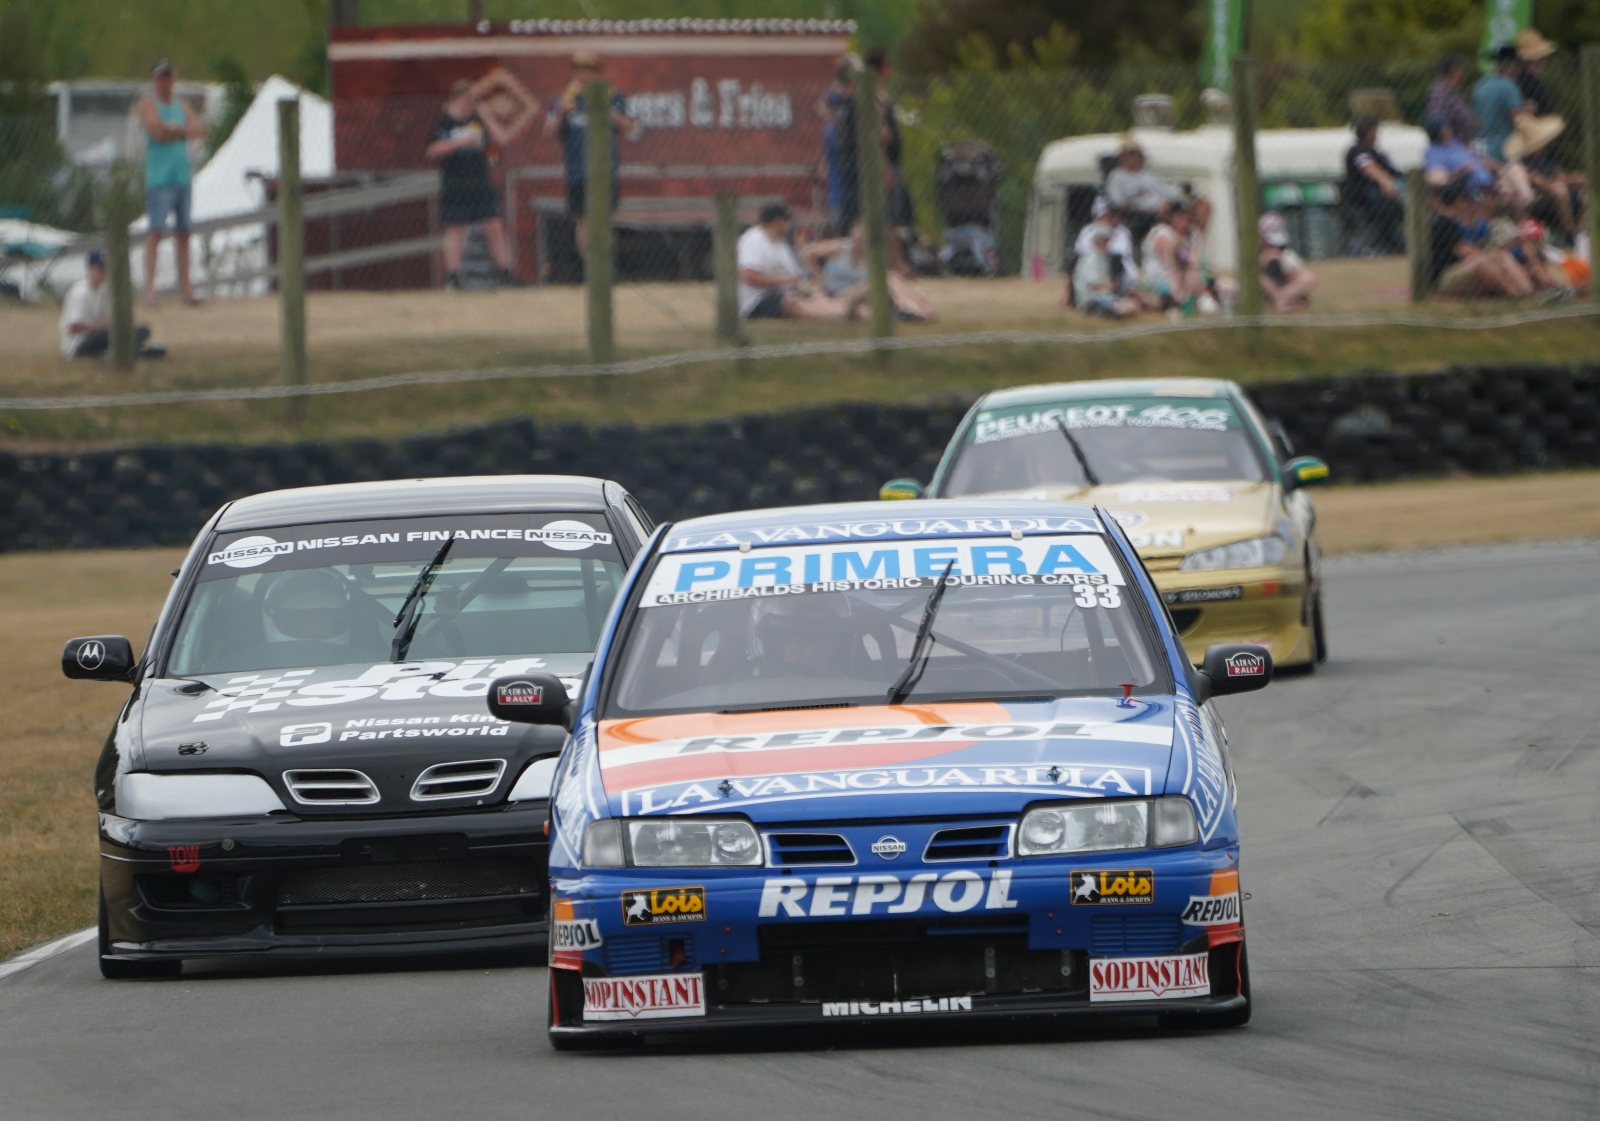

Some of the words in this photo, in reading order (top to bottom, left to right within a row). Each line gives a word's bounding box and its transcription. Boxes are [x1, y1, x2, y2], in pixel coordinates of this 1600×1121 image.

[690, 76, 714, 129] &
[717, 79, 792, 130] Fries
[975, 404, 1134, 439] PEUGEOT
[1139, 404, 1231, 427] 406
[297, 532, 400, 550] NISSAN
[407, 529, 523, 542] FINANCE
[529, 531, 608, 542] NISSAN
[674, 532, 742, 550] LA
[749, 518, 1098, 543] VANGUARDIA
[212, 543, 290, 562] NISSAN
[674, 544, 1100, 592] PRIMERA
[658, 583, 805, 604] ARCHIBALDS
[812, 576, 923, 593] HISTORIC
[927, 574, 1037, 587] TOURING
[1041, 573, 1108, 585] CARS
[1072, 584, 1121, 609] 33
[352, 657, 547, 686] Pit
[1229, 657, 1261, 668] RADIANT
[500, 687, 539, 696] RADIANT
[505, 695, 534, 703] RALLY
[338, 725, 509, 742] Partsworld
[345, 716, 440, 729] Nissan
[677, 723, 1093, 754] REPSOL
[638, 782, 717, 816] LA
[730, 767, 1138, 797] VANGUARDIA
[167, 845, 199, 866] TOW
[872, 844, 905, 852] NISSAN
[758, 869, 1019, 918] REPSOL
[1100, 871, 1151, 896] Lois
[651, 889, 703, 915] Lois
[1181, 896, 1239, 923] REPSOL
[652, 915, 671, 923] JEANS
[1092, 956, 1208, 991] SOPINSTANT
[585, 977, 701, 1009] SOPINSTANT
[822, 996, 972, 1017] MICHELIN
